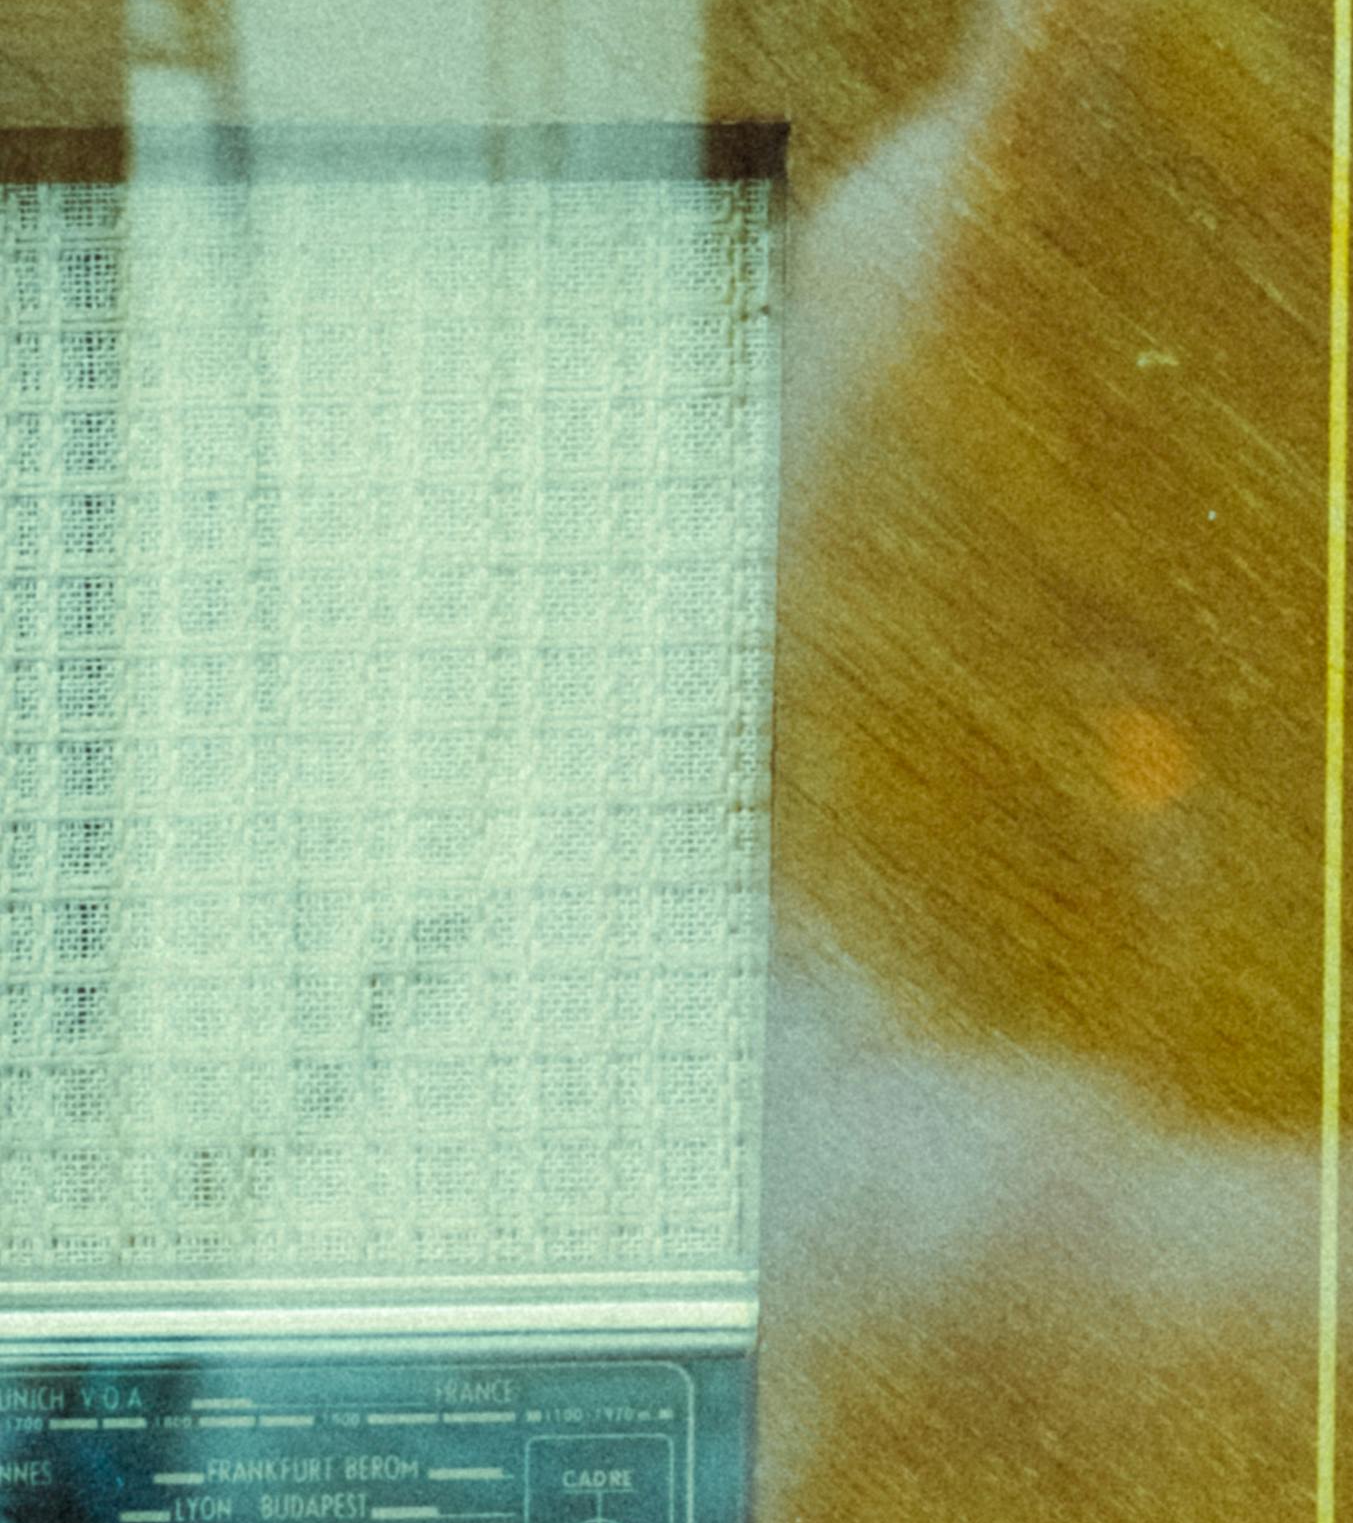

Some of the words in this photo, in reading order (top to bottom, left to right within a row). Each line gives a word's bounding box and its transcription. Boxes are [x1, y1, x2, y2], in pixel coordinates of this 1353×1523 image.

[206, 1456, 333, 1484] FRANKFURT
[562, 1468, 635, 1488] CADRE
[175, 1495, 233, 1523] LYON
[259, 1492, 369, 1520] BUDAPEST
